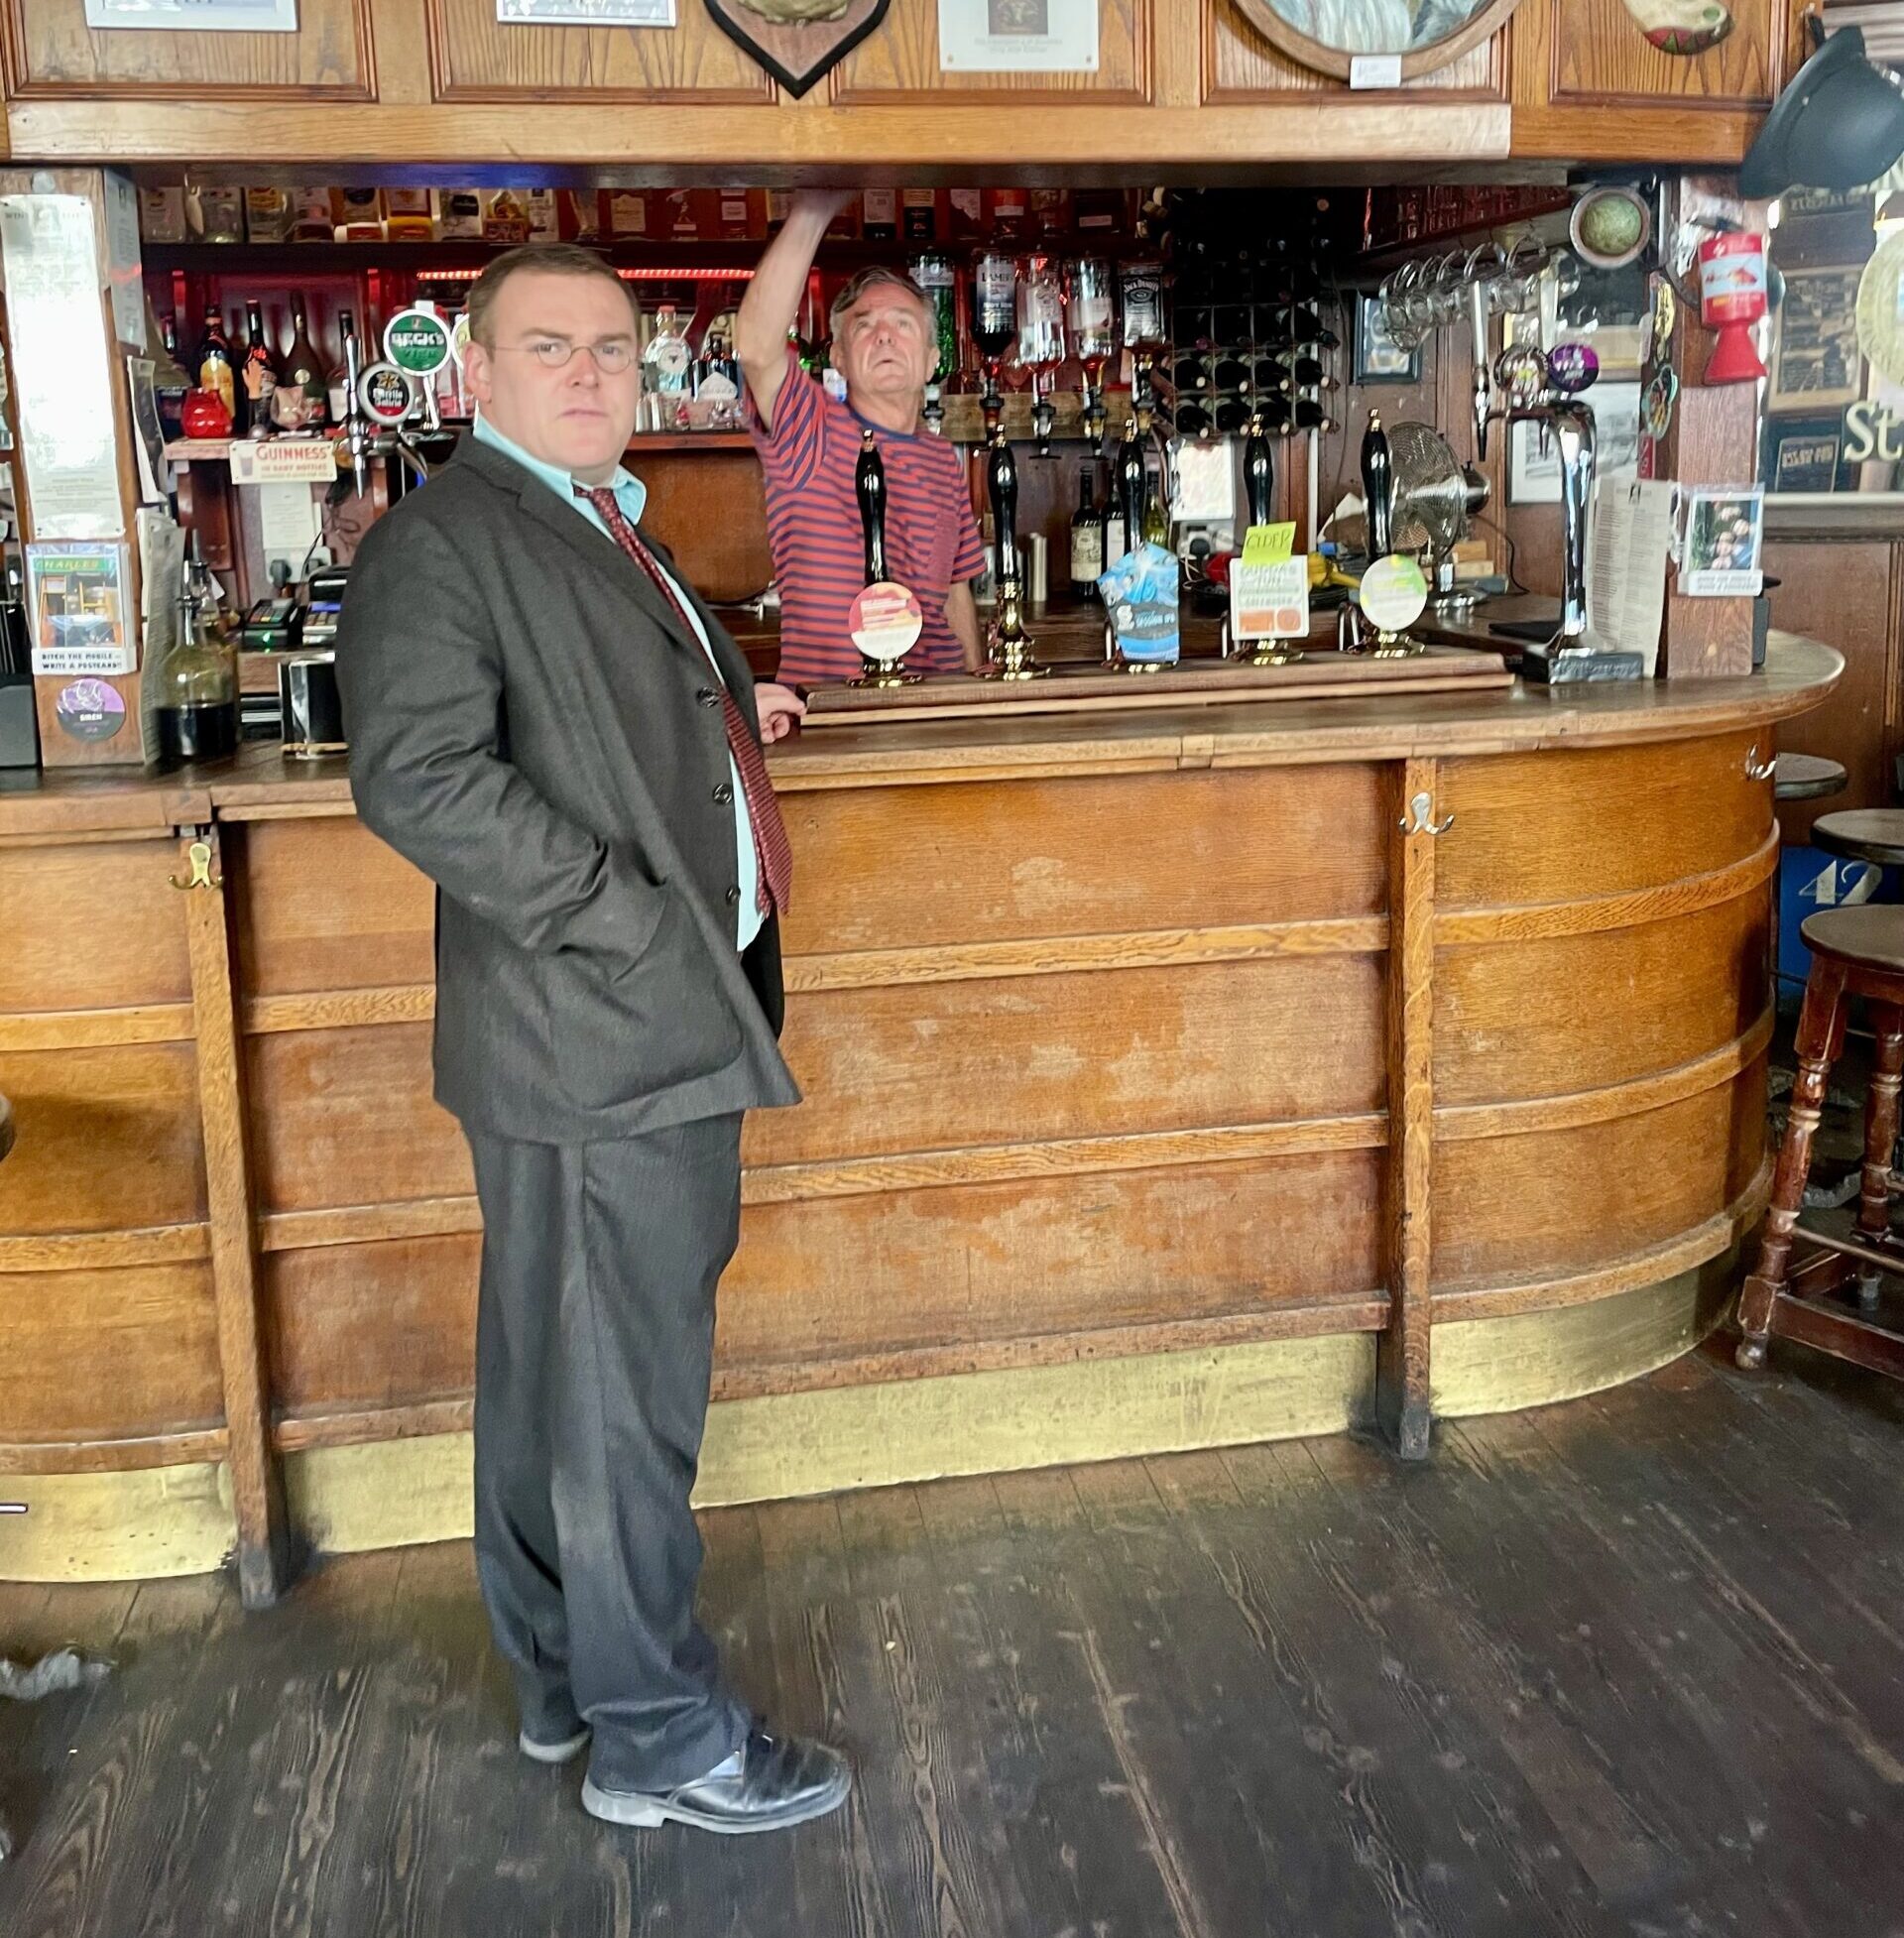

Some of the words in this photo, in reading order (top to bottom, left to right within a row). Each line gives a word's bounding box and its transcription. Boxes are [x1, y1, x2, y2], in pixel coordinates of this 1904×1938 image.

[391, 332, 445, 347] BECK'S
[1844, 401, 1903, 461] St
[256, 445, 327, 460] GUINNESS
[1246, 529, 1292, 549] CIDER
